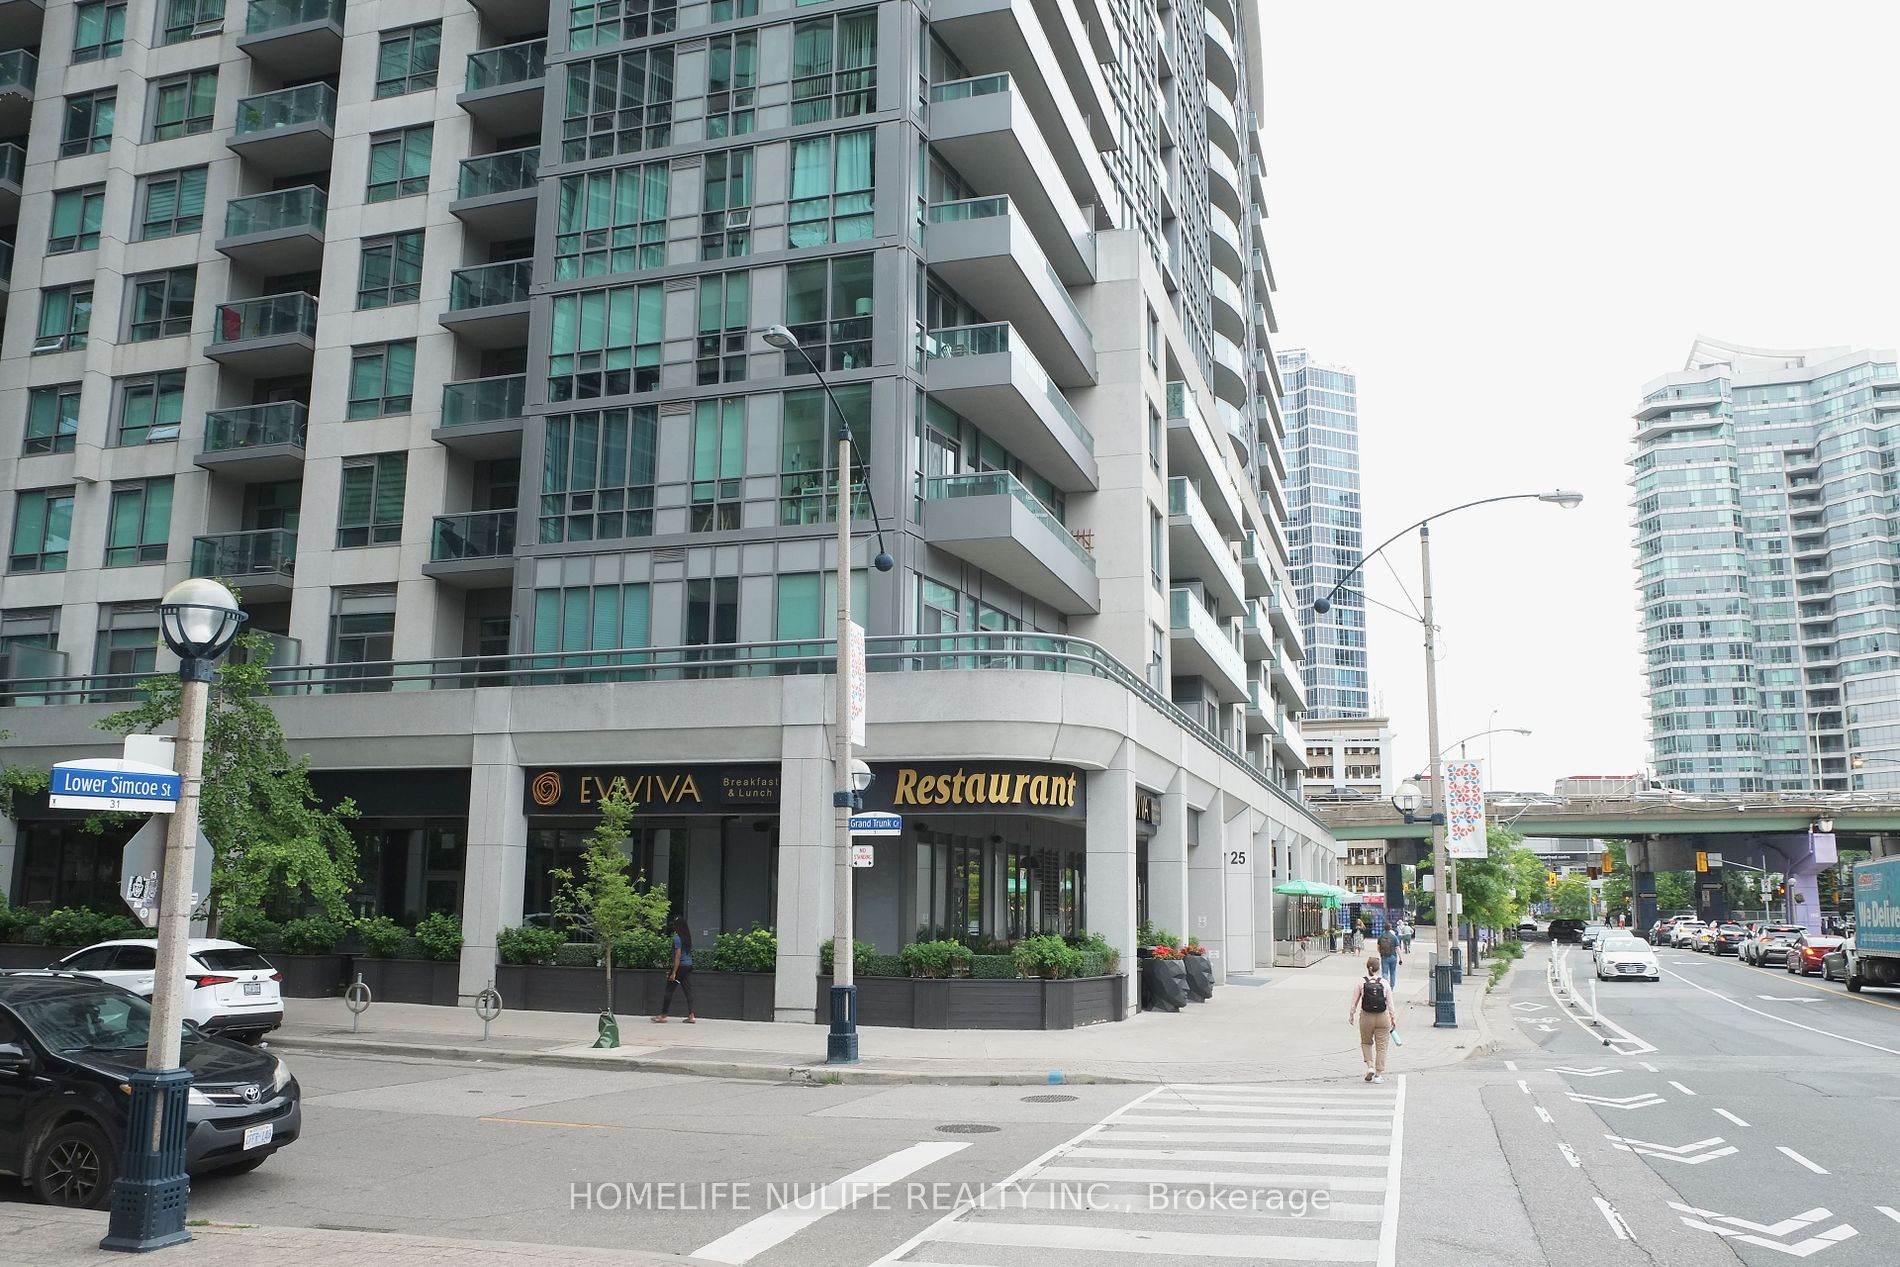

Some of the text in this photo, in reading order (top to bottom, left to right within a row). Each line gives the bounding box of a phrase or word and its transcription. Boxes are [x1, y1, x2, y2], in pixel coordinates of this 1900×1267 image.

[64, 773, 171, 797] Lower Simcoe St
[580, 774, 702, 803] EVVIVA
[723, 777, 779, 787] Breakfast
[893, 767, 1076, 807] Restaurant
[727, 788, 772, 797] & Lunch
[110, 800, 120, 808] 31
[850, 819, 871, 828] Grand
[872, 819, 891, 828] Trunk
[1230, 851, 1246, 865] 25
[1858, 901, 1871, 928] We
